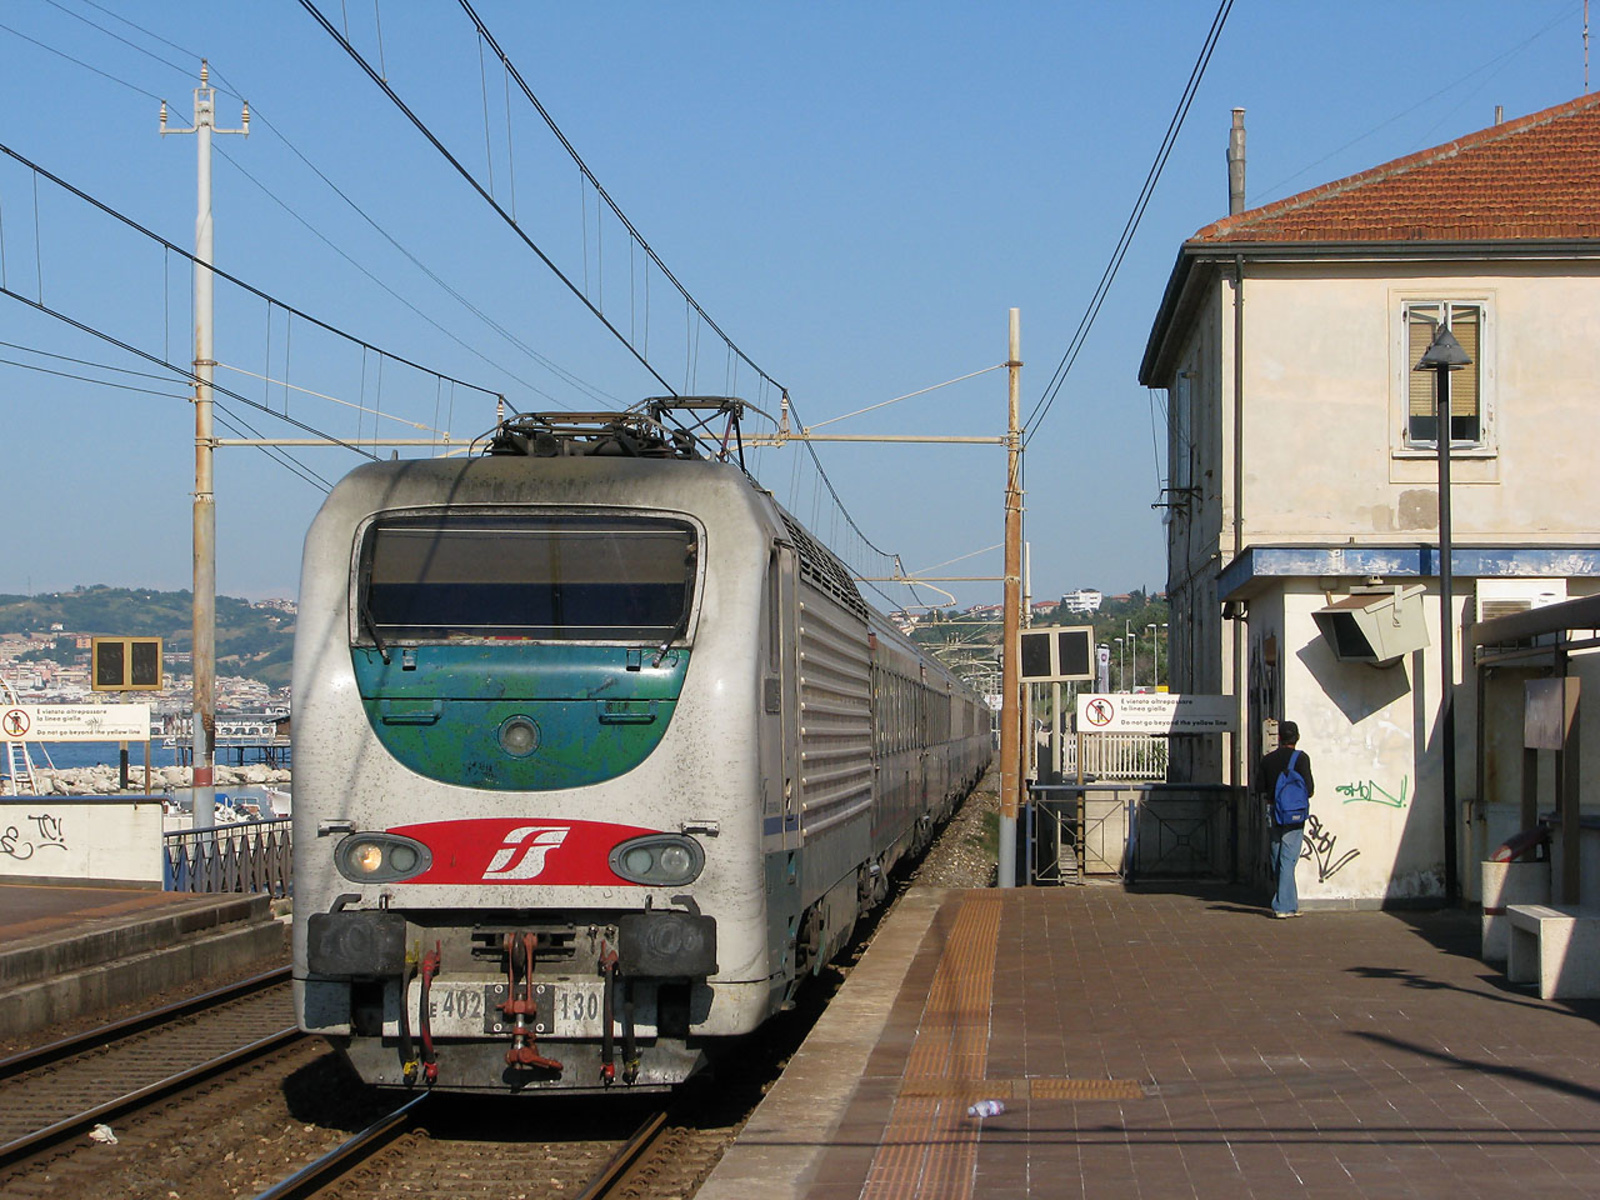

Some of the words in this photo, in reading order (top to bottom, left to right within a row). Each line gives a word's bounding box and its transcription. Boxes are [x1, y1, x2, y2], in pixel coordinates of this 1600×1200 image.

[66, 708, 107, 716] oltrepassare
[441, 990, 481, 1019] 402
[559, 992, 598, 1021] 130
